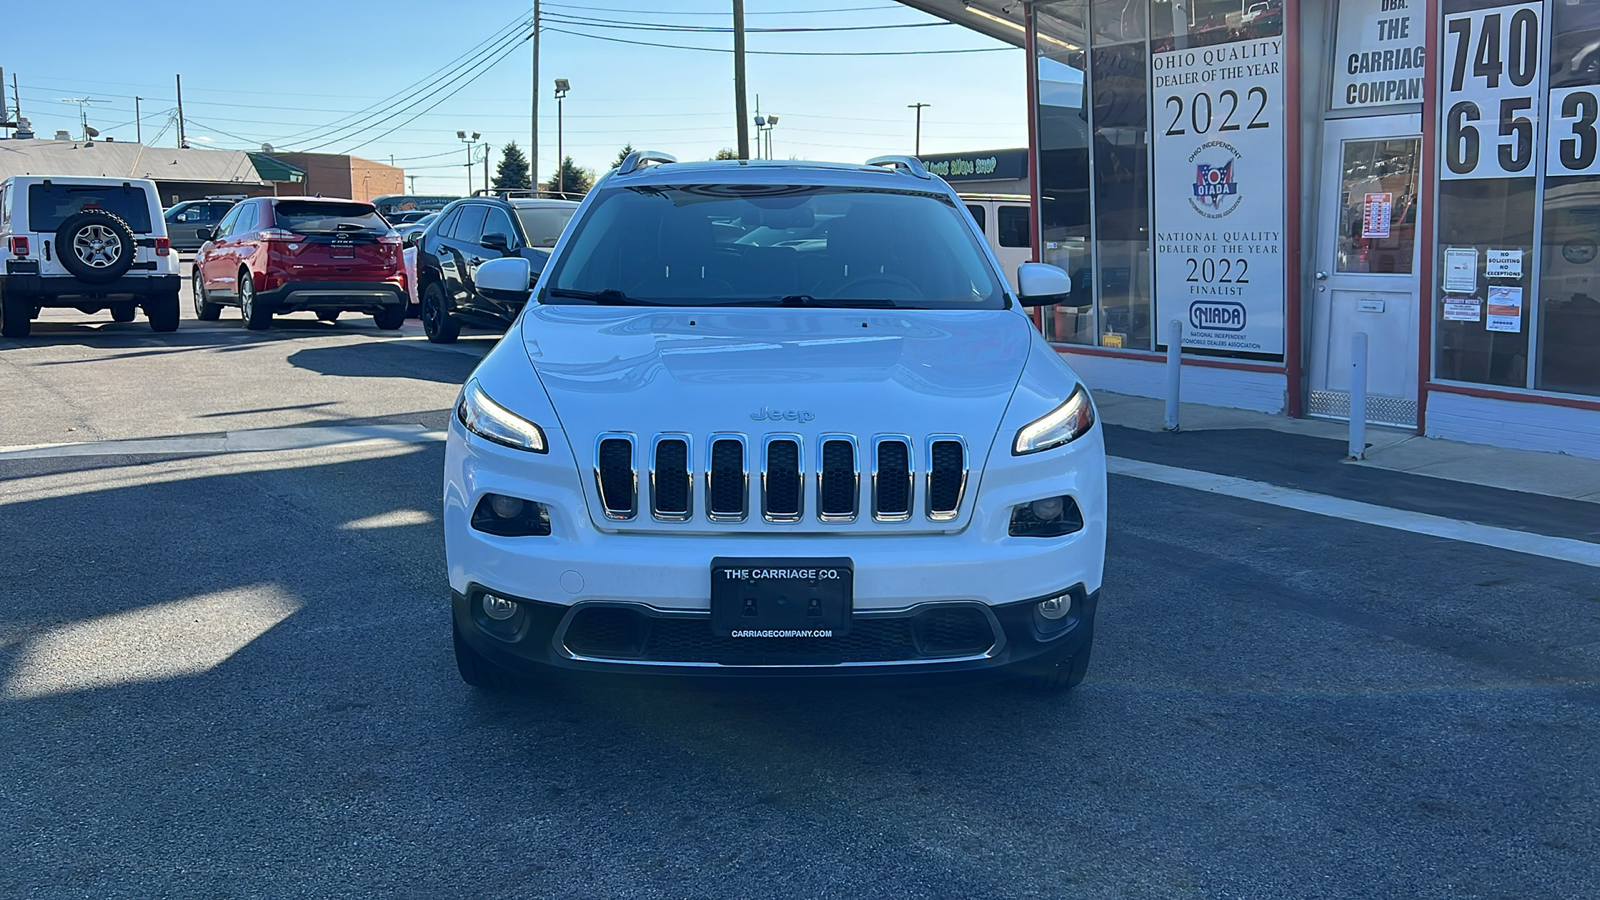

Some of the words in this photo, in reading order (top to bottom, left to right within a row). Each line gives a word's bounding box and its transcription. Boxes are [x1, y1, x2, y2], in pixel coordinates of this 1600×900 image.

[1377, 16, 1410, 41] THE
[1154, 52, 1195, 71] OHIO
[1203, 40, 1282, 66] QUALITY
[1448, 8, 1538, 92] 740
[1347, 46, 1425, 75] CARRIAG
[1155, 72, 1199, 88] DEALER
[1201, 69, 1217, 83] OF
[1219, 66, 1244, 80] THE
[1246, 61, 1280, 77] YEAR
[1165, 86, 1270, 136] 2022
[1188, 147, 1202, 163] OHIO
[1201, 140, 1243, 160] INDEPENDENT
[975, 156, 997, 175] SHOP
[1197, 184, 1230, 195] OIADA
[1157, 232, 1218, 242] NATIONAL
[1223, 231, 1280, 243] QUALITY
[1159, 244, 1199, 254] DEALER
[1203, 245, 1217, 253] OF
[1222, 245, 1243, 253] THE
[1248, 245, 1279, 254] YEAR
[1185, 257, 1249, 284] 2022
[1190, 285, 1244, 296] FINALIST
[1193, 307, 1241, 325] NIADA
[1206, 339, 1227, 347] DEALERS
[1227, 341, 1261, 349] ASSOCIATION
[1214, 332, 1247, 340] INDEPENDENT
[750, 406, 816, 423] Jeep
[724, 569, 750, 580] THE
[751, 569, 817, 580] CARRIAGE
[818, 569, 841, 580] CO.
[731, 629, 833, 638] CARRIAGECOMPANY.COM
